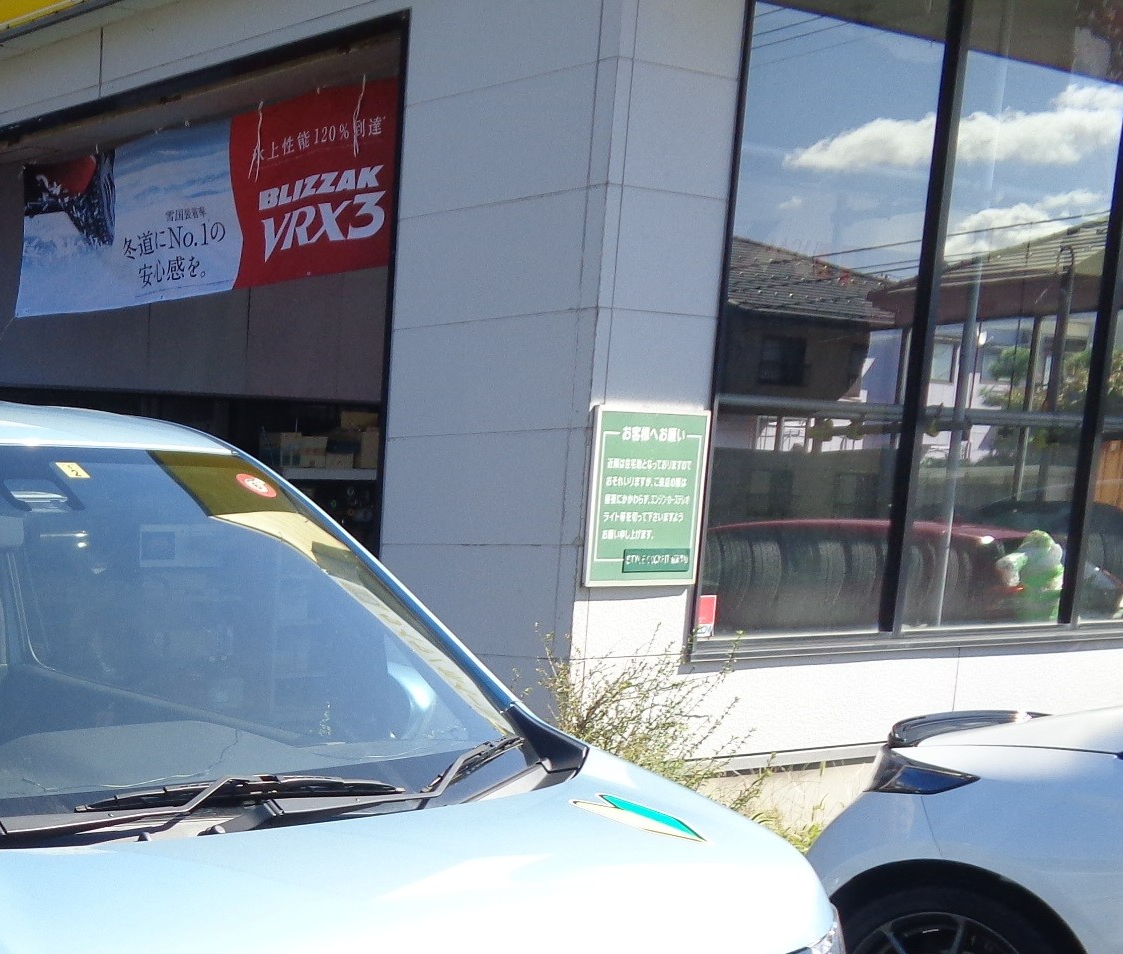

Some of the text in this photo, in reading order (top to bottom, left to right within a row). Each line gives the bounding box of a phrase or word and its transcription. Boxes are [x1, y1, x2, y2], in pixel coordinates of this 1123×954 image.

[259, 164, 385, 211] BLIZZAK
[123, 221, 226, 260] 冬道にNo.1の
[261, 190, 386, 263] VRX3
[138, 256, 206, 288] 安心感を。
